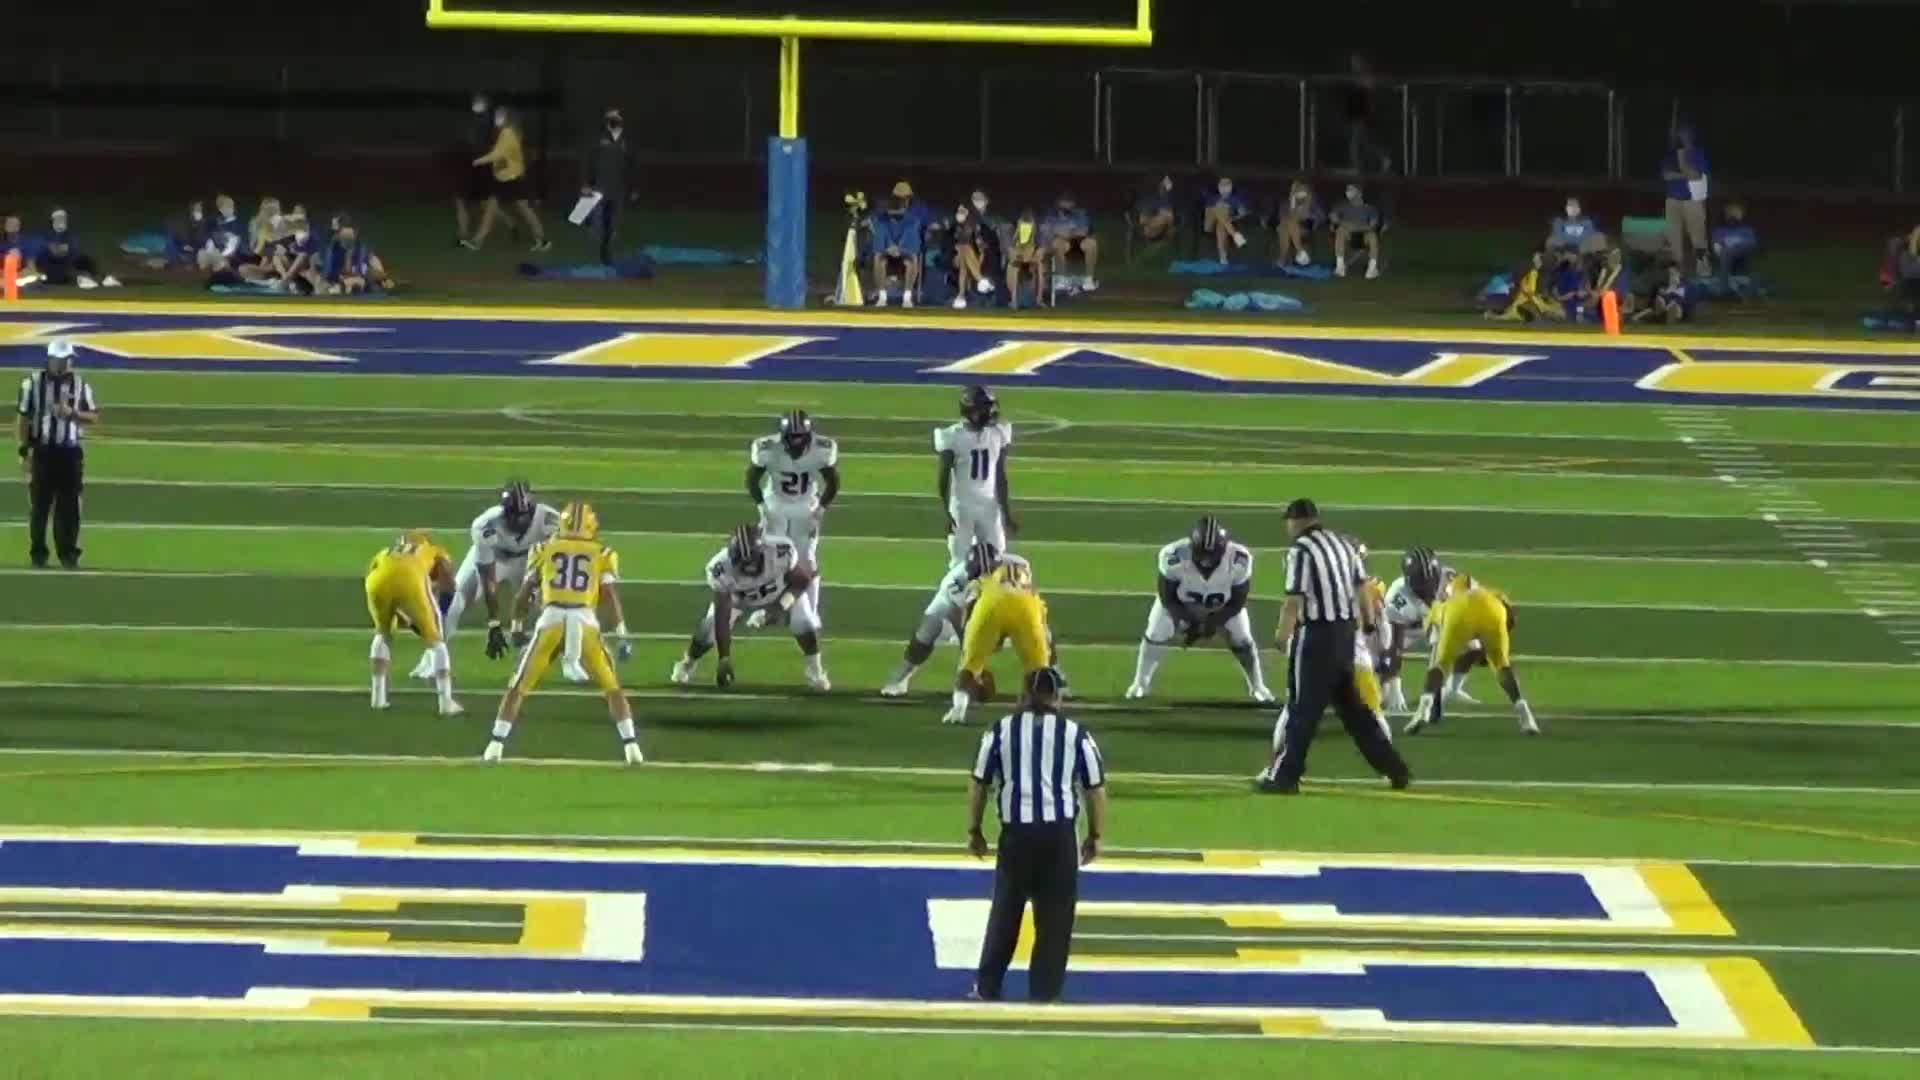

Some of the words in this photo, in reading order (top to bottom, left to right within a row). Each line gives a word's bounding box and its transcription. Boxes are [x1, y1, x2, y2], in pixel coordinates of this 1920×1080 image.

[970, 448, 991, 481] 11
[780, 471, 809, 496] 21
[550, 551, 591, 592] 36
